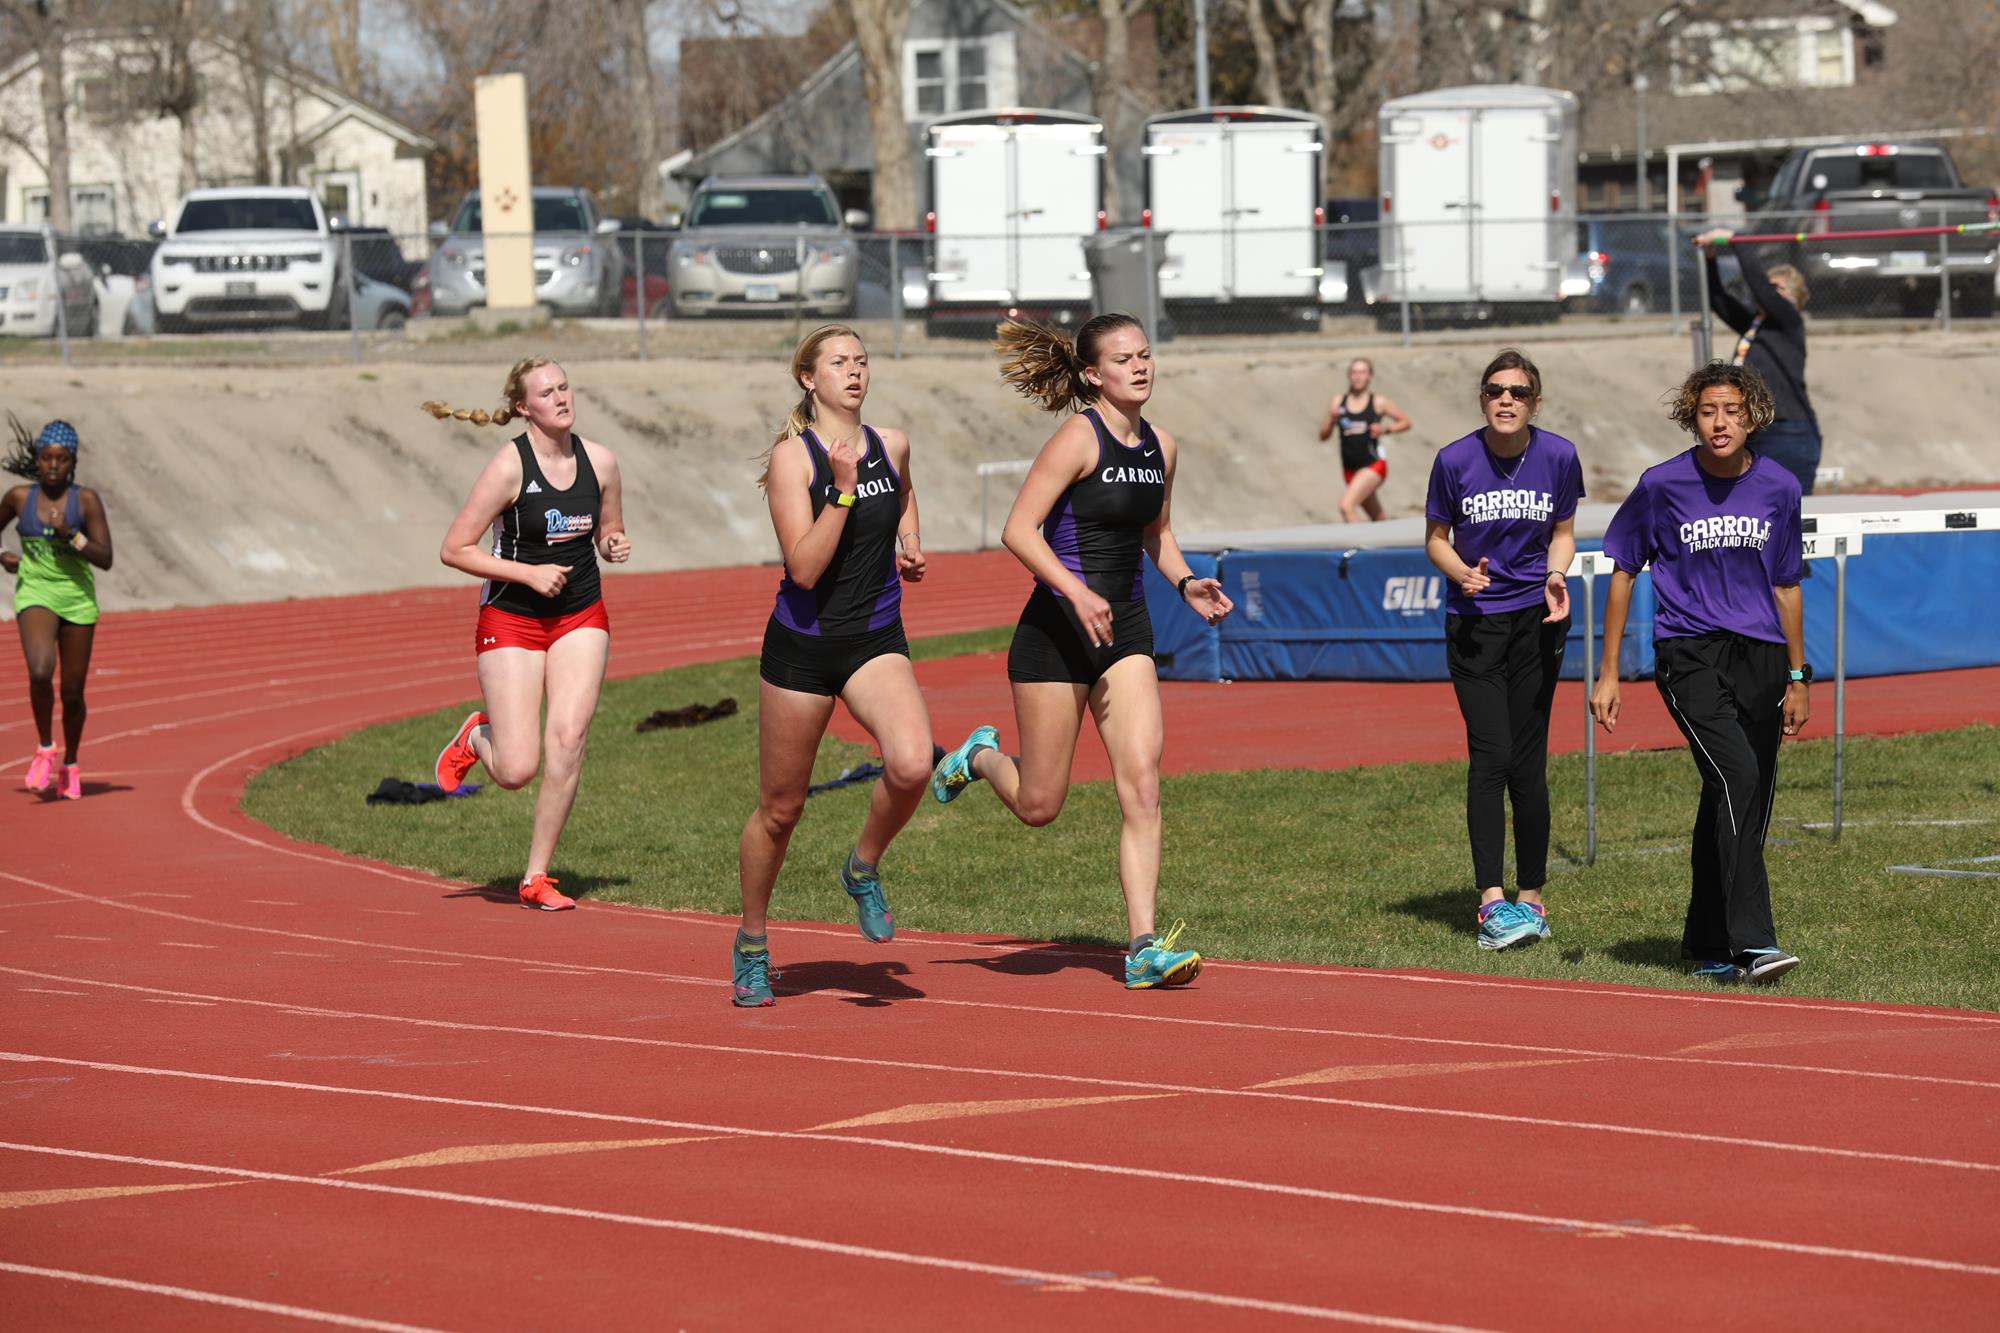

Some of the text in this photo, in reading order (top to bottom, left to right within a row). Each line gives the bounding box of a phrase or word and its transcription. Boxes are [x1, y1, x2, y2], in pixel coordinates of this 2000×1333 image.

[1462, 489, 1553, 515] CARROLL
[1470, 508, 1547, 524] TRACK AND FIELD
[1680, 515, 1772, 544] CARROLL
[1689, 537, 1721, 553] TRACK
[1722, 536, 1741, 548] AND
[1383, 576, 1441, 610] GILL
